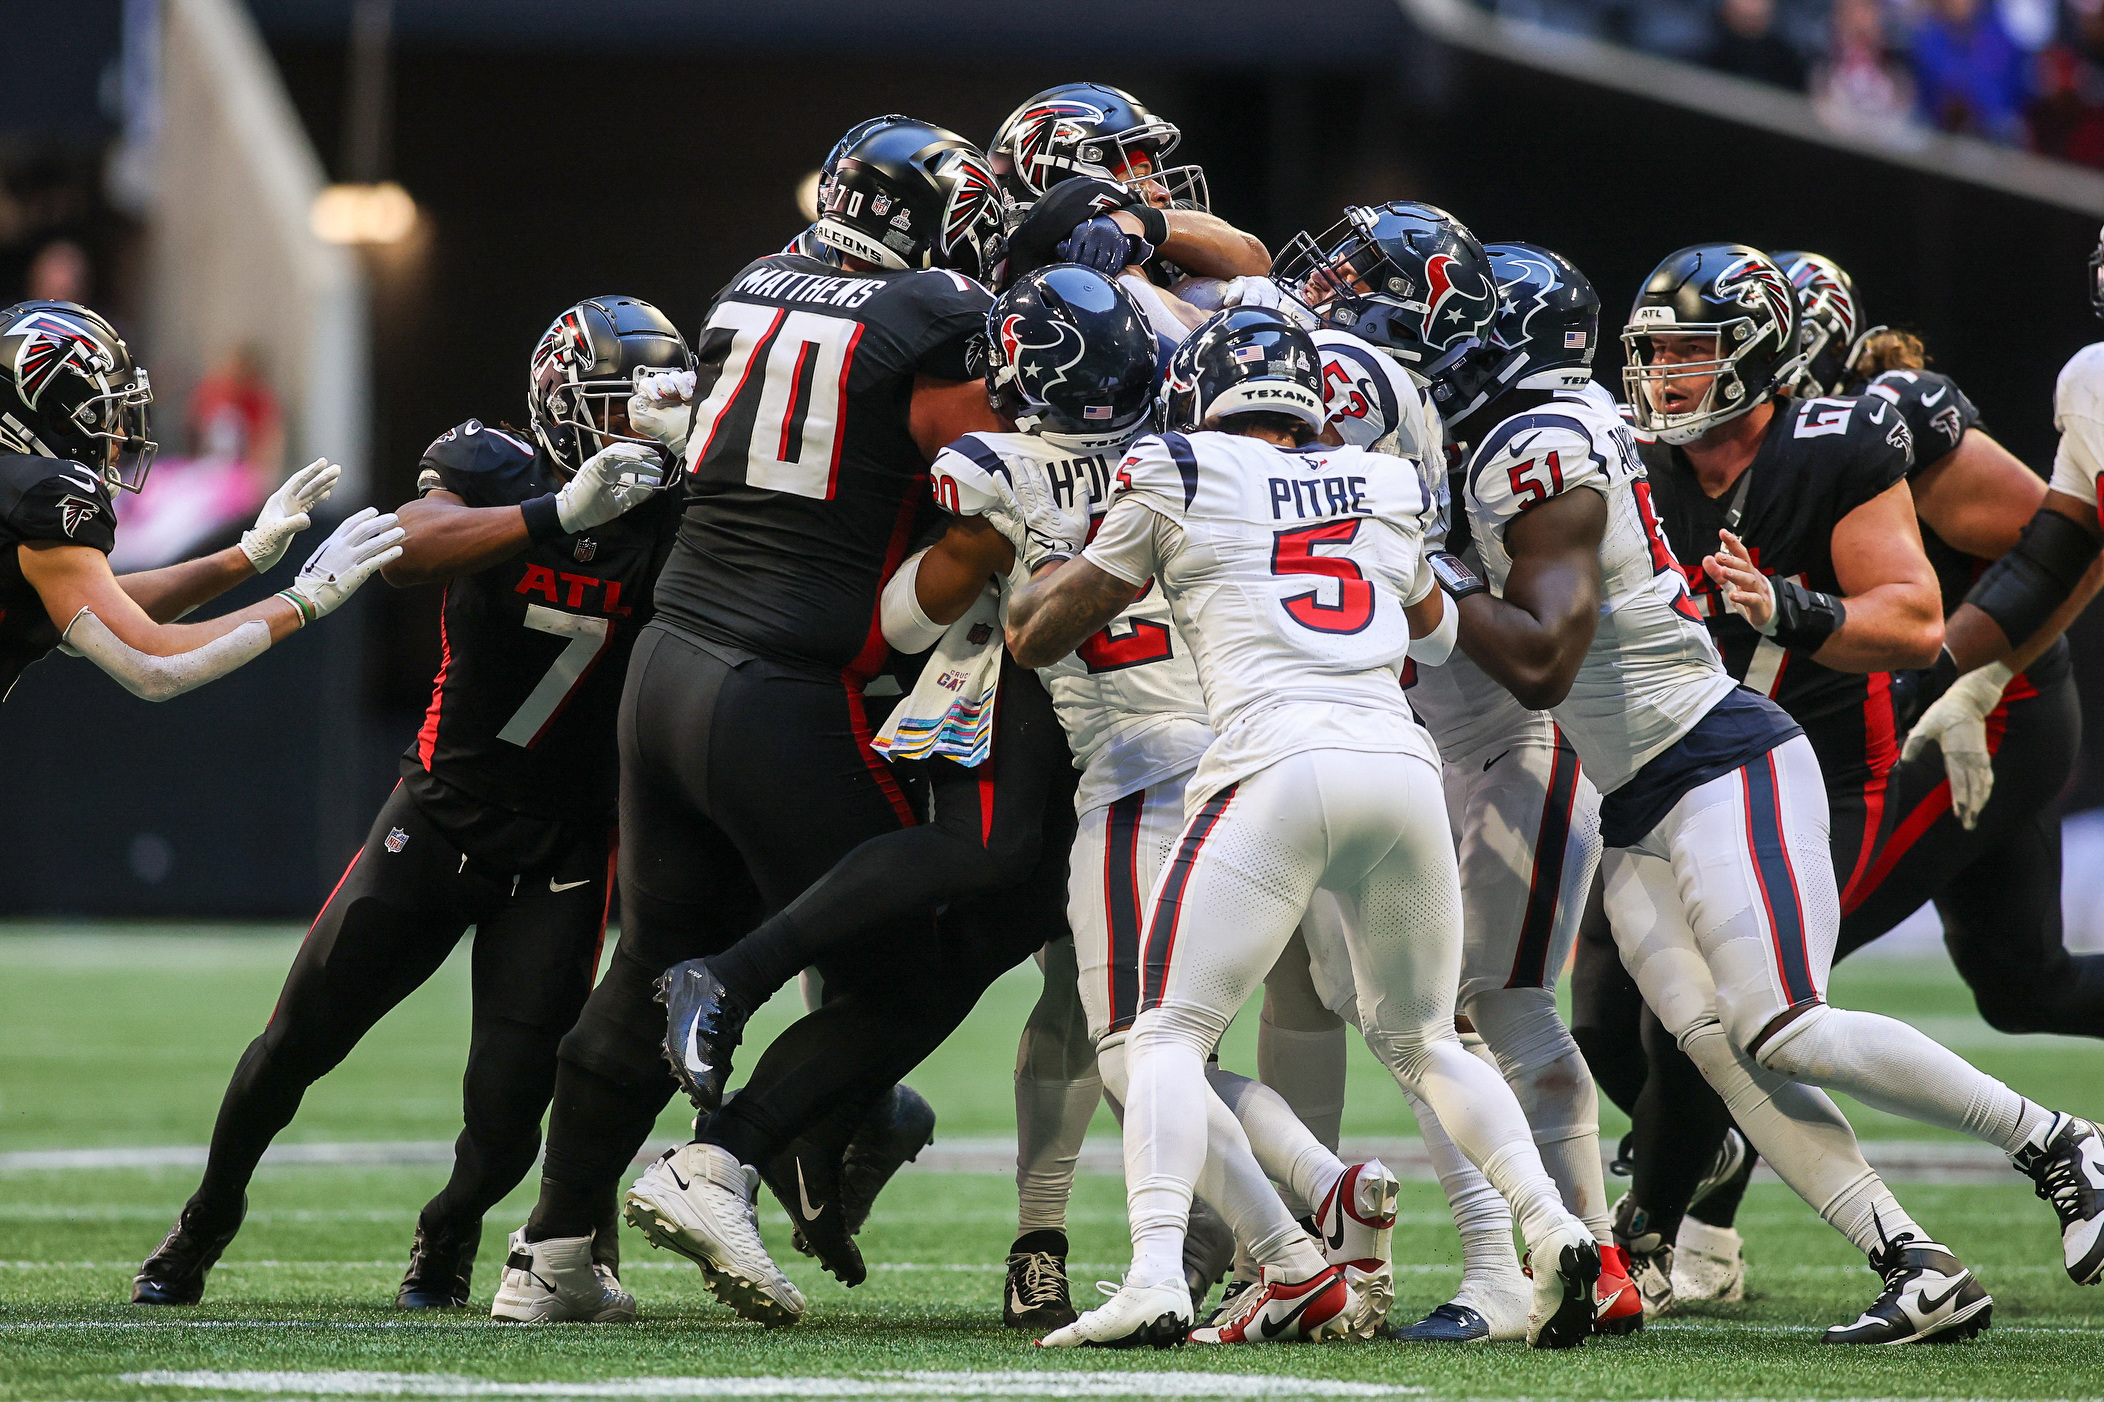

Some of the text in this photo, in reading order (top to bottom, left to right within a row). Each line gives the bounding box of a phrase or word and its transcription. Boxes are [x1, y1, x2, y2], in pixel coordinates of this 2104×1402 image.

[832, 184, 864, 219] 70
[734, 268, 888, 309] MATTHEWS
[1641, 310, 1662, 318] ATL
[685, 300, 865, 500] 70
[1241, 389, 1315, 408] TEXANS
[1268, 476, 1373, 520] PITRE
[1507, 450, 1564, 511] 51
[514, 562, 632, 617] ATL
[1270, 517, 1375, 636] 5
[496, 603, 616, 750] 7
